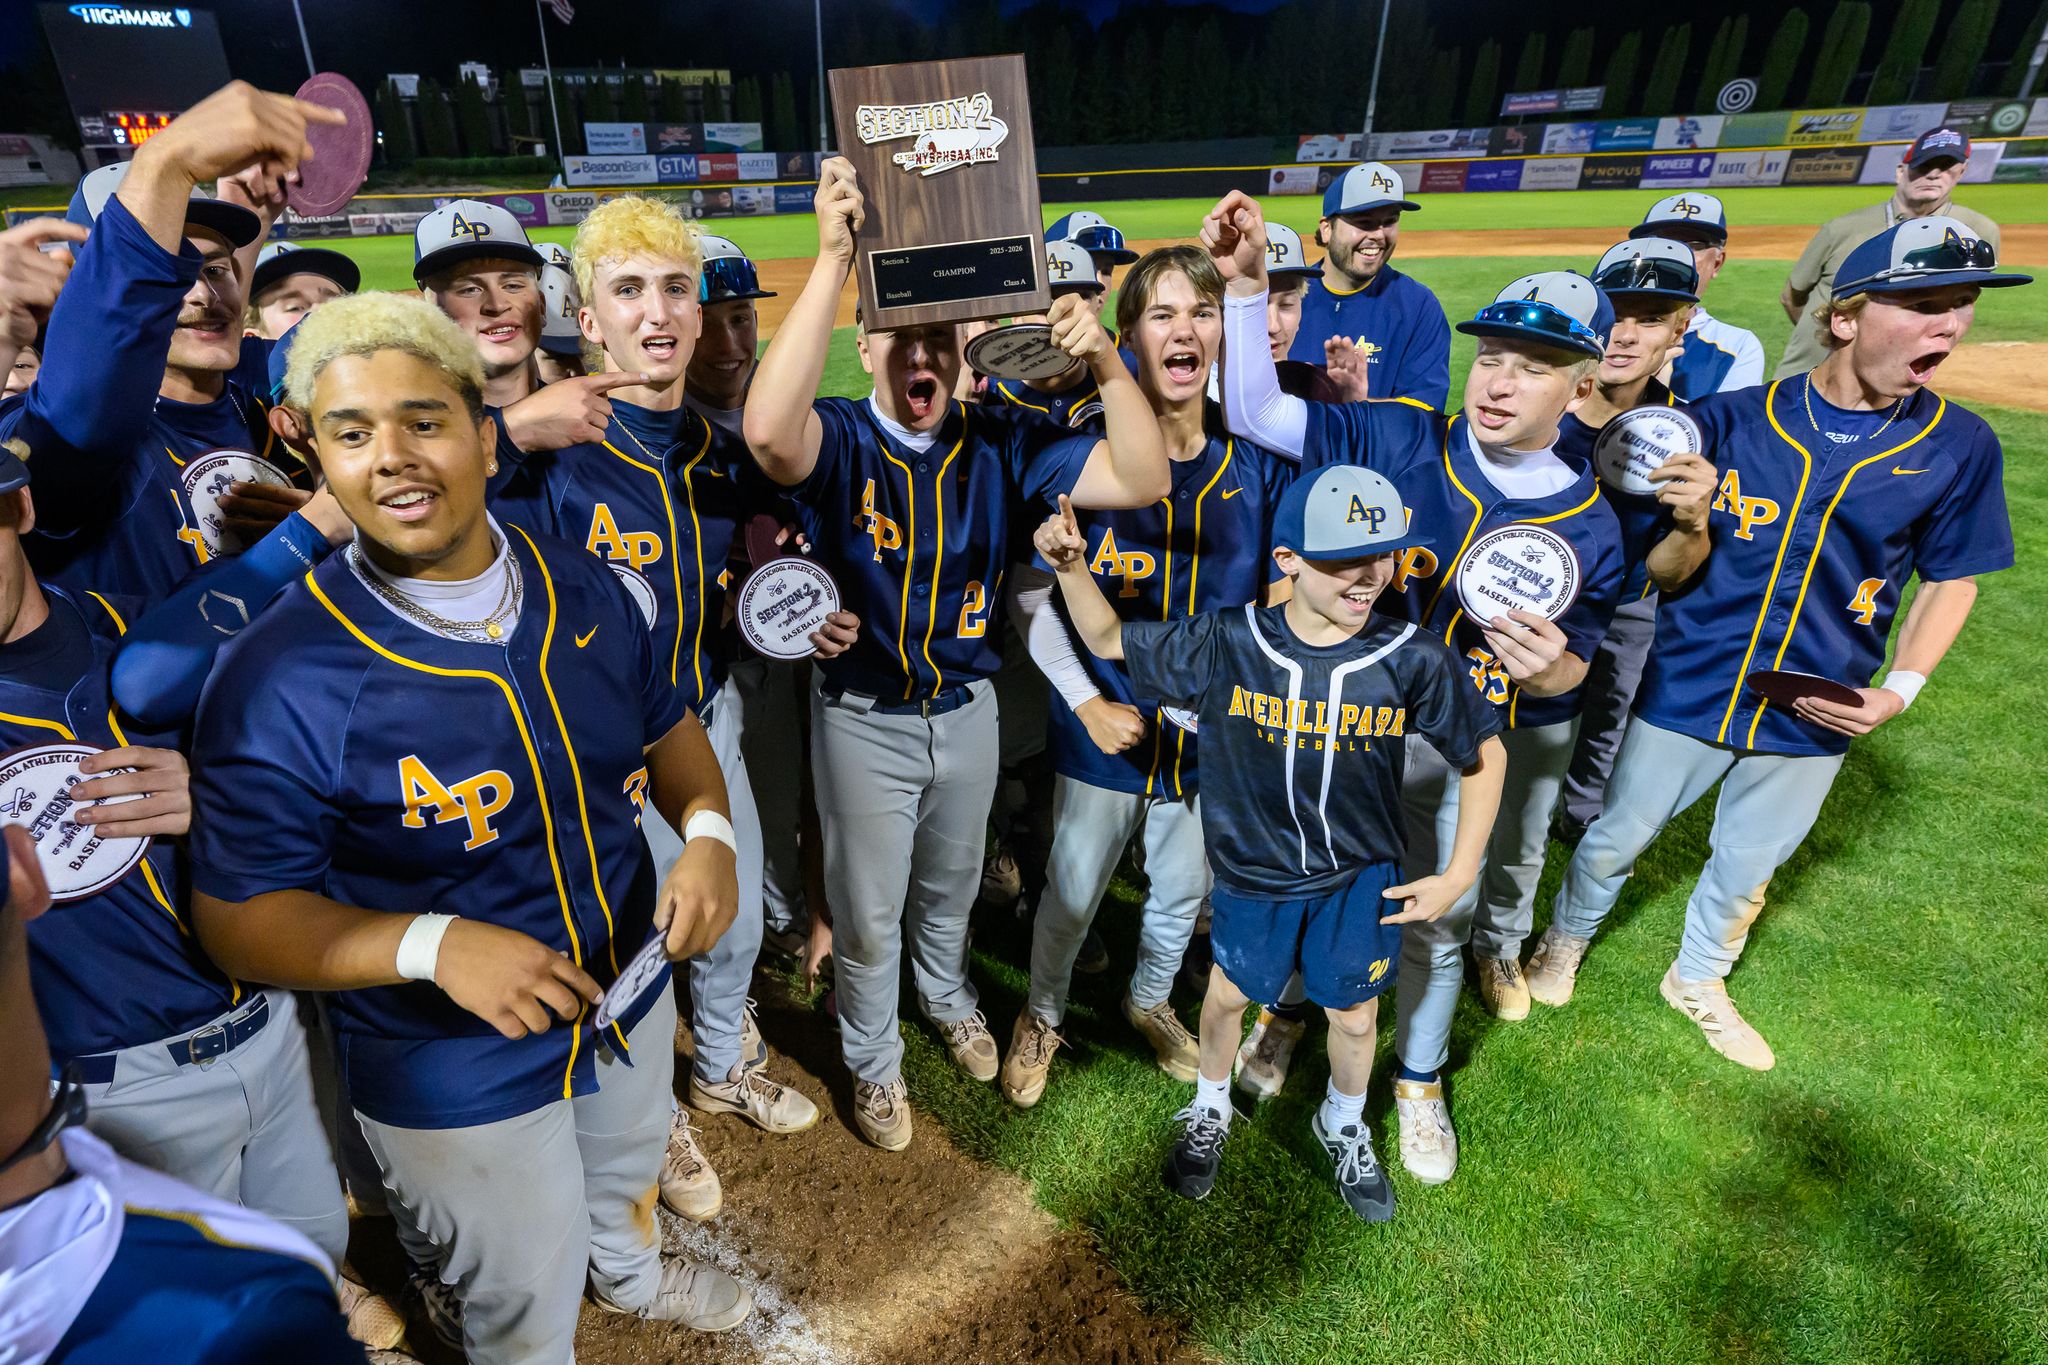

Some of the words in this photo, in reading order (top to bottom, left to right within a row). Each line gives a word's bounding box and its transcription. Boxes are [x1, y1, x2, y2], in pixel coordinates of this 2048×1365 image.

[81, 8, 175, 27] HIGHMARK
[858, 100, 968, 139] SECTION
[973, 95, 991, 130] 2
[582, 160, 650, 173] BeaconBank
[658, 157, 696, 174] GTM
[713, 163, 737, 171] TOYOTA
[1597, 166, 1642, 177] NOVUS
[1649, 158, 1695, 170] PIONEER
[1718, 162, 1747, 174] TASTE
[1371, 171, 1394, 193] AP
[552, 194, 594, 208] GRECO
[1670, 197, 1701, 218] AP
[451, 212, 492, 243] AP
[881, 257, 905, 267] Section
[905, 256, 910, 264] 2
[933, 266, 976, 278] CHAMPION
[1048, 252, 1074, 279] AP
[886, 290, 912, 300] Baseball
[192, 459, 230, 485] ASSOCIATION
[1347, 494, 1387, 535] AP
[1711, 468, 1781, 541] AP
[852, 477, 904, 564] AP
[586, 503, 664, 573] AP
[1484, 535, 1503, 549] STATE
[1502, 531, 1525, 540] PUBLIC
[1525, 532, 1542, 541] HIGH
[1541, 536, 1562, 555] SCHOOL
[1089, 526, 1156, 599] AP
[1473, 545, 1487, 560] YORK
[1465, 560, 1476, 573] NEW
[1487, 550, 1544, 587] SECTION
[1541, 577, 1555, 592] 2
[1559, 553, 1571, 581] ATHLETIC
[745, 583, 758, 605] PUBLIC
[765, 565, 787, 579] SCHOOL
[787, 564, 814, 576] ATHLETIC
[811, 571, 834, 601] ASSOCIATION
[756, 587, 806, 625] SECTION
[802, 582, 815, 598] 2
[1545, 580, 1571, 614] ASSOCIATION
[1846, 577, 1888, 626] 4
[956, 580, 987, 639] 2
[781, 615, 823, 643] BASEBALL
[1228, 685, 1331, 735] AVERILL
[1339, 704, 1406, 737] PARK
[1257, 728, 1371, 752] BASEBALL
[22, 754, 73, 771] ATHLETIC
[397, 754, 514, 852] AP
